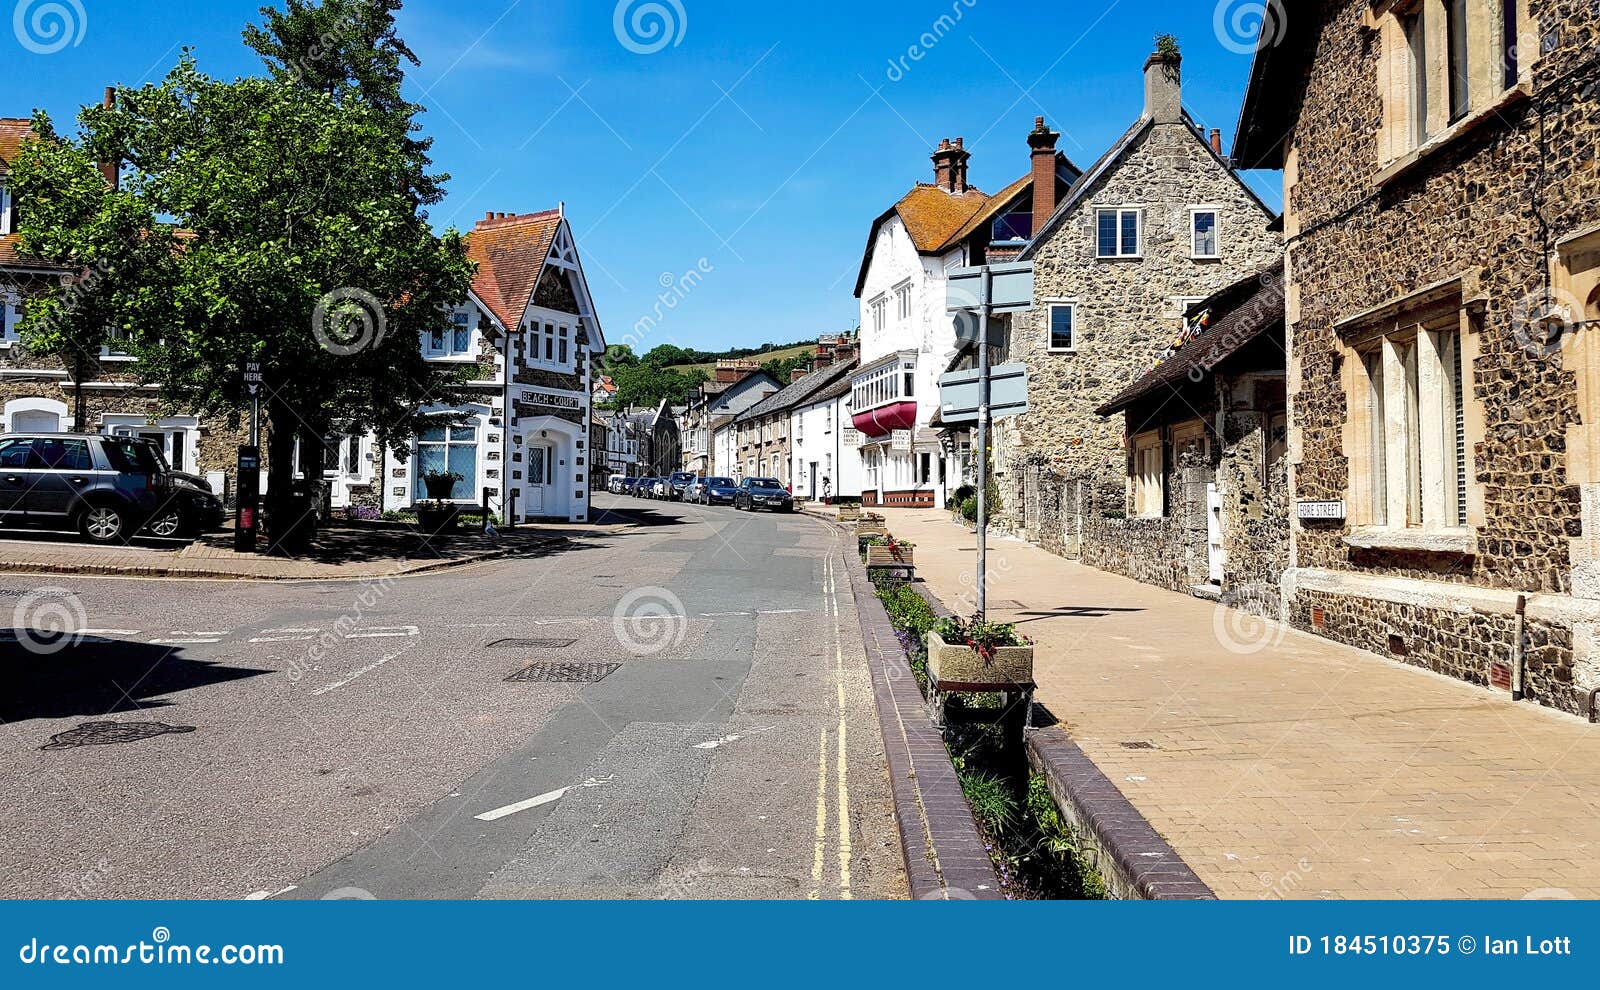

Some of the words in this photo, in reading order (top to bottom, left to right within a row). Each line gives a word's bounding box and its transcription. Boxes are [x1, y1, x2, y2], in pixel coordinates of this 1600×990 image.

[246, 362, 261, 372] PAY
[243, 372, 263, 382] HERE
[522, 391, 549, 404] BEACH
[554, 396, 579, 408] COURT
[1300, 504, 1315, 517] FORE
[1316, 504, 1339, 517] STREET
